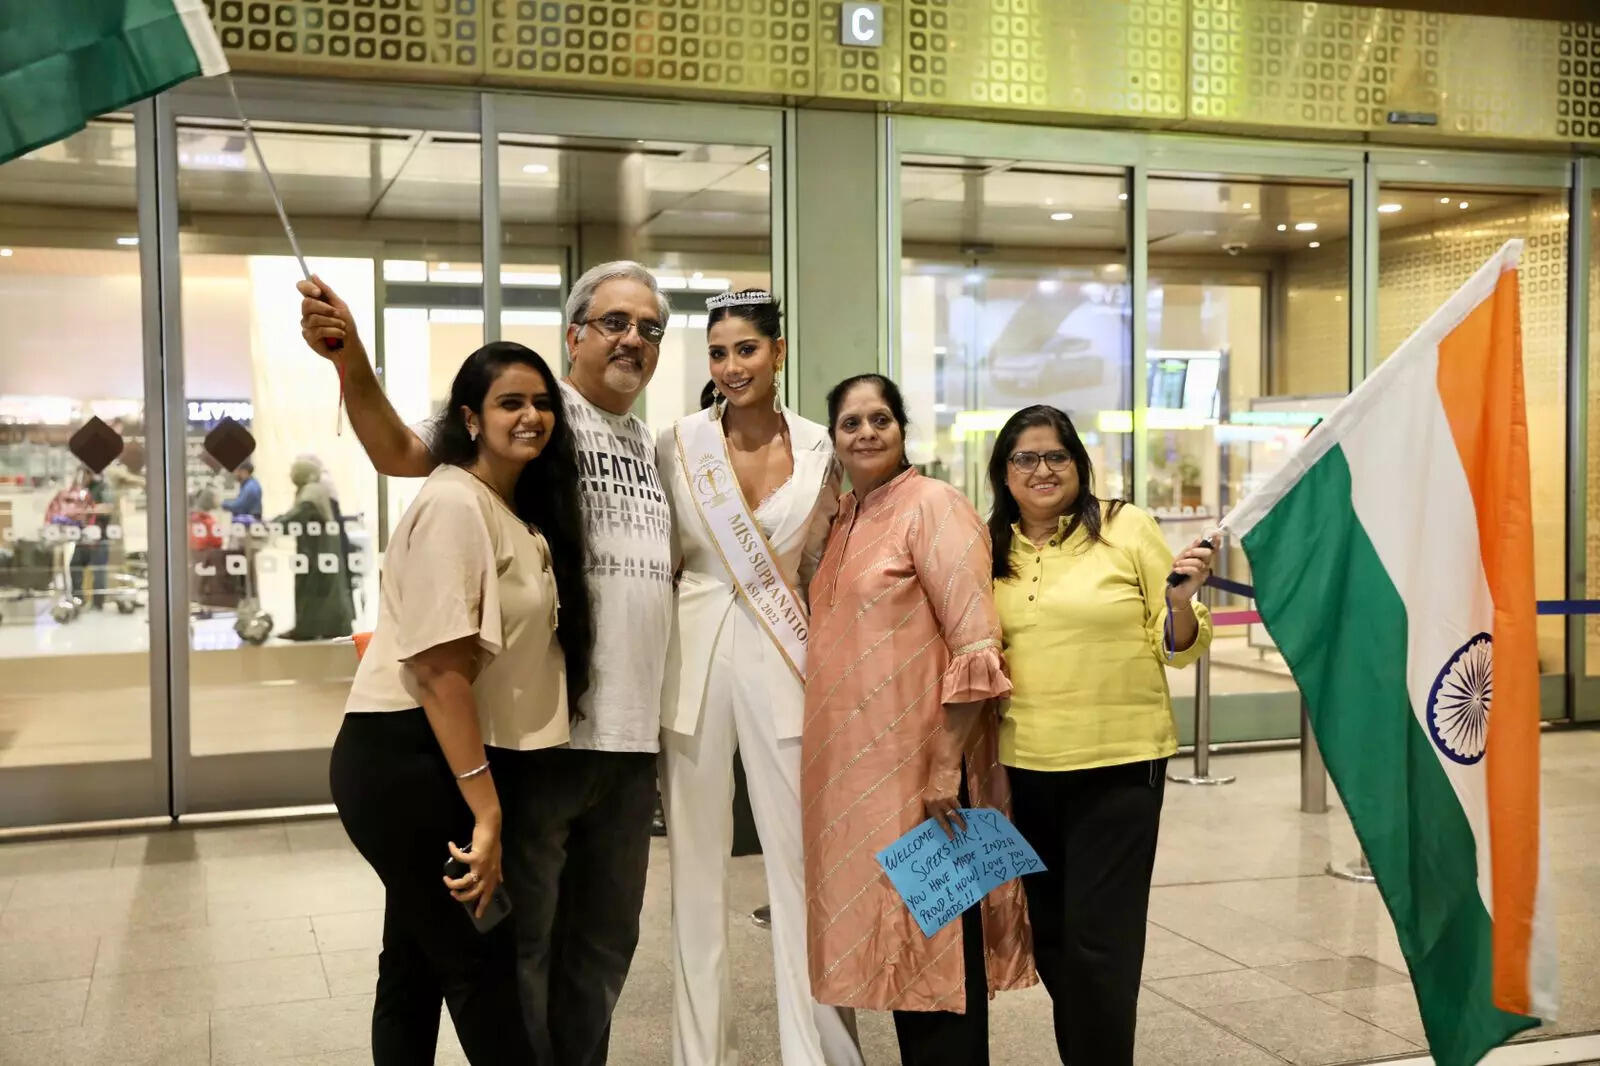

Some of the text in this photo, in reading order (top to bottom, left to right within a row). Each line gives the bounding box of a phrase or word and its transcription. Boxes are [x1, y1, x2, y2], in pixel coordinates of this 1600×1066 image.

[852, 8, 874, 41] C
[728, 513, 758, 553] MISS
[744, 582, 781, 626] ASIA 2022
[885, 826, 935, 871] WELCOME
[907, 837, 1015, 911] YOU HAVE MADE INDIA
[920, 897, 945, 925] PROUD
[982, 857, 1004, 876] LOVE
[1008, 850, 1024, 860] YOU
